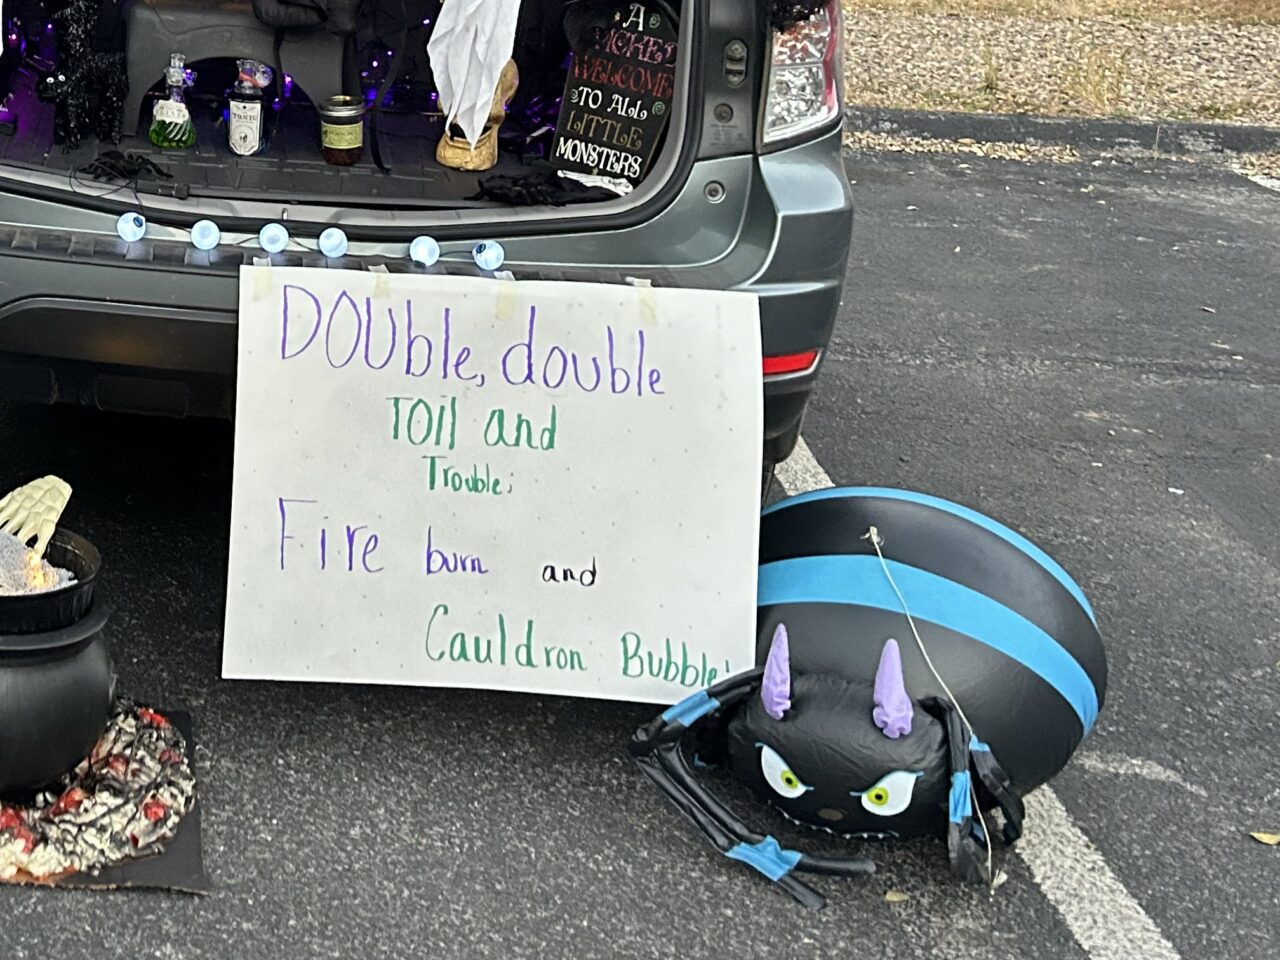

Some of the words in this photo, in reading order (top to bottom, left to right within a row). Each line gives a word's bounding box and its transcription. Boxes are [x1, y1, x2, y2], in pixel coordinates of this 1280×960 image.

[622, 2, 646, 32] A
[592, 25, 677, 68] ICKED
[573, 52, 673, 100] WELCOME
[232, 112, 258, 121] TONIC
[578, 86, 603, 110] TO
[607, 93, 648, 121] ALL
[567, 111, 642, 150] LITTLE
[556, 137, 642, 178] MONSTERS
[502, 305, 666, 396] double
[484, 404, 557, 451] and
[278, 497, 384, 574] Fire
[426, 526, 489, 575] burn
[542, 557, 598, 587] and
[425, 603, 588, 672] Cauldron
